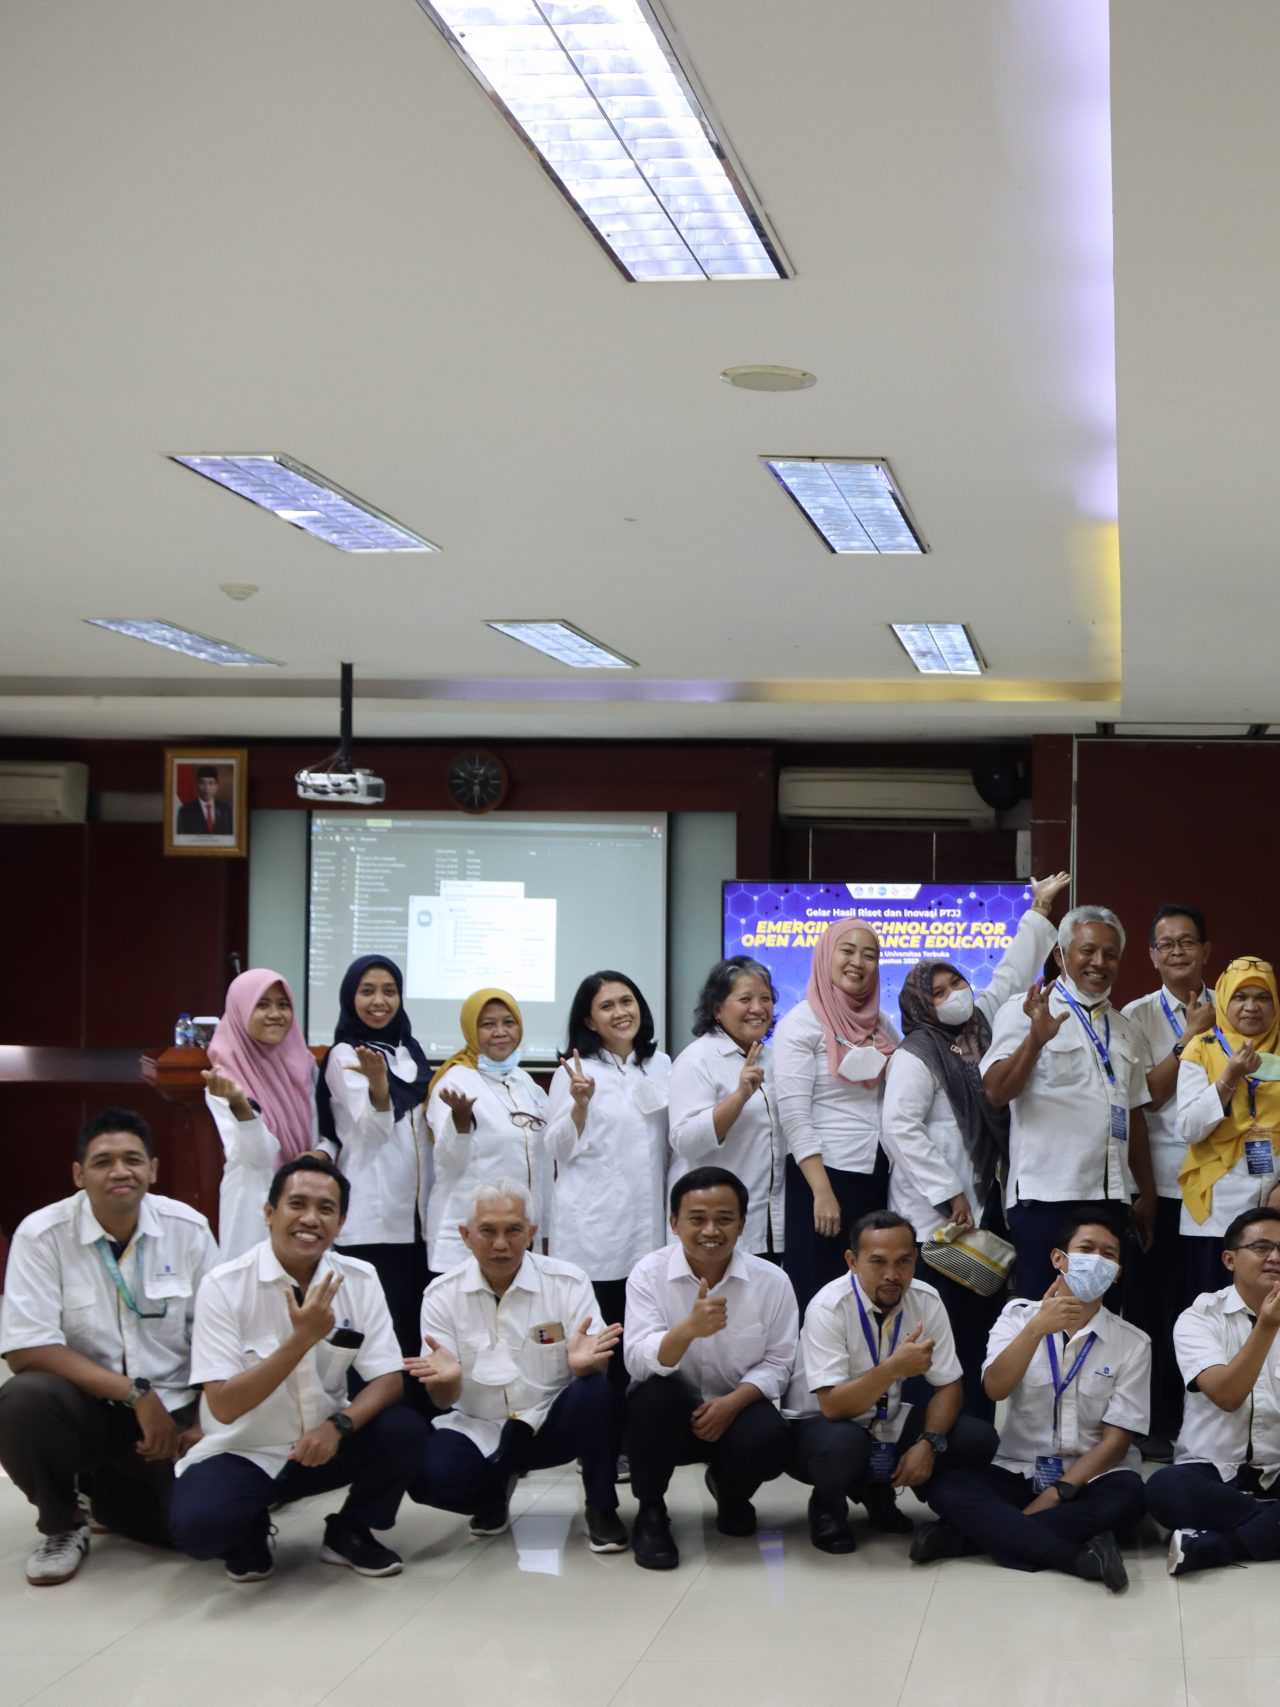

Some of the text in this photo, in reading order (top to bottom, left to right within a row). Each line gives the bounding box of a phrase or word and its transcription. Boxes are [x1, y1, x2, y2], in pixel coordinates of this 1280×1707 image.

[806, 908, 961, 918] Gelar Hasil Riset dan Inovasi PTJJ
[756, 921, 1006, 935] EMERGIN CHNOLOGY FOR
[741, 934, 789, 947] OPEN
[791, 935, 819, 947] AN
[925, 935, 1014, 948] EDUCATIO
